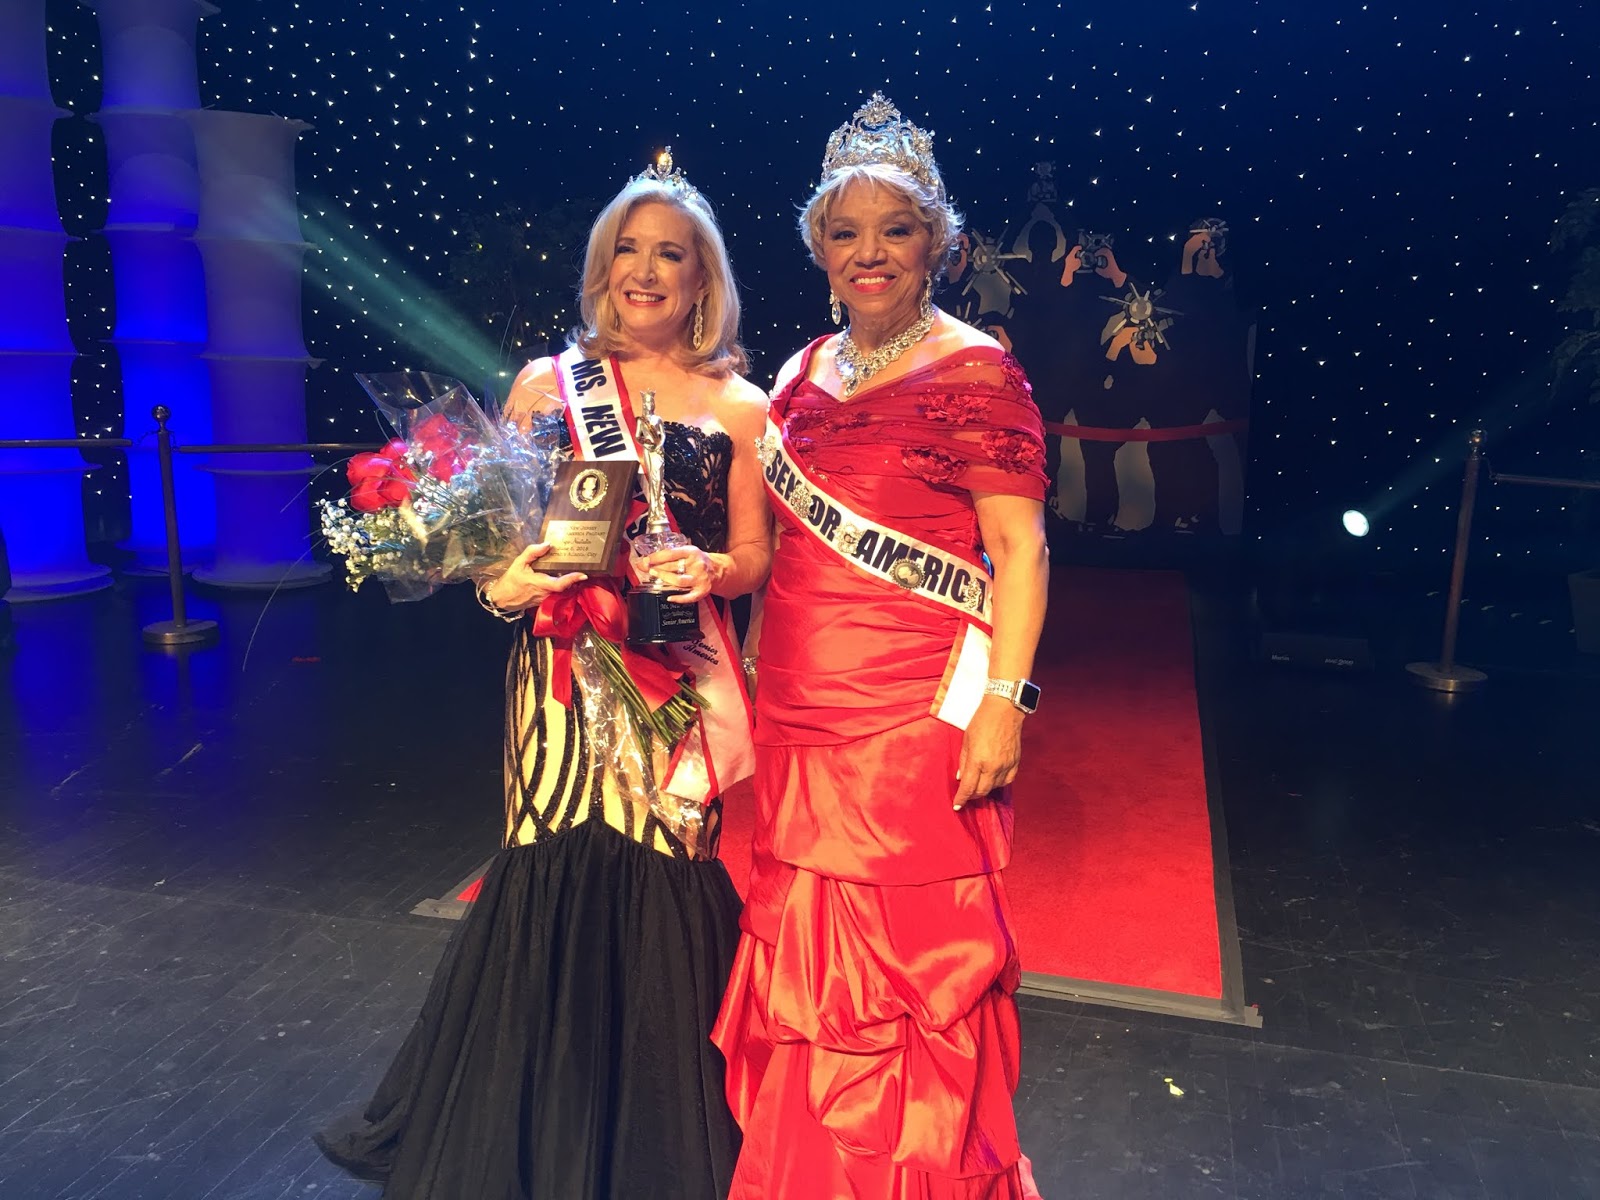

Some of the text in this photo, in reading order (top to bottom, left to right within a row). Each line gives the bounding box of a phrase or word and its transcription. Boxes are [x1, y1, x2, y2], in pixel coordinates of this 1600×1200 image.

[570, 359, 627, 459] MS. NEW
[765, 449, 842, 542] SENOR
[677, 618, 696, 626] America
[682, 645, 719, 665] America
